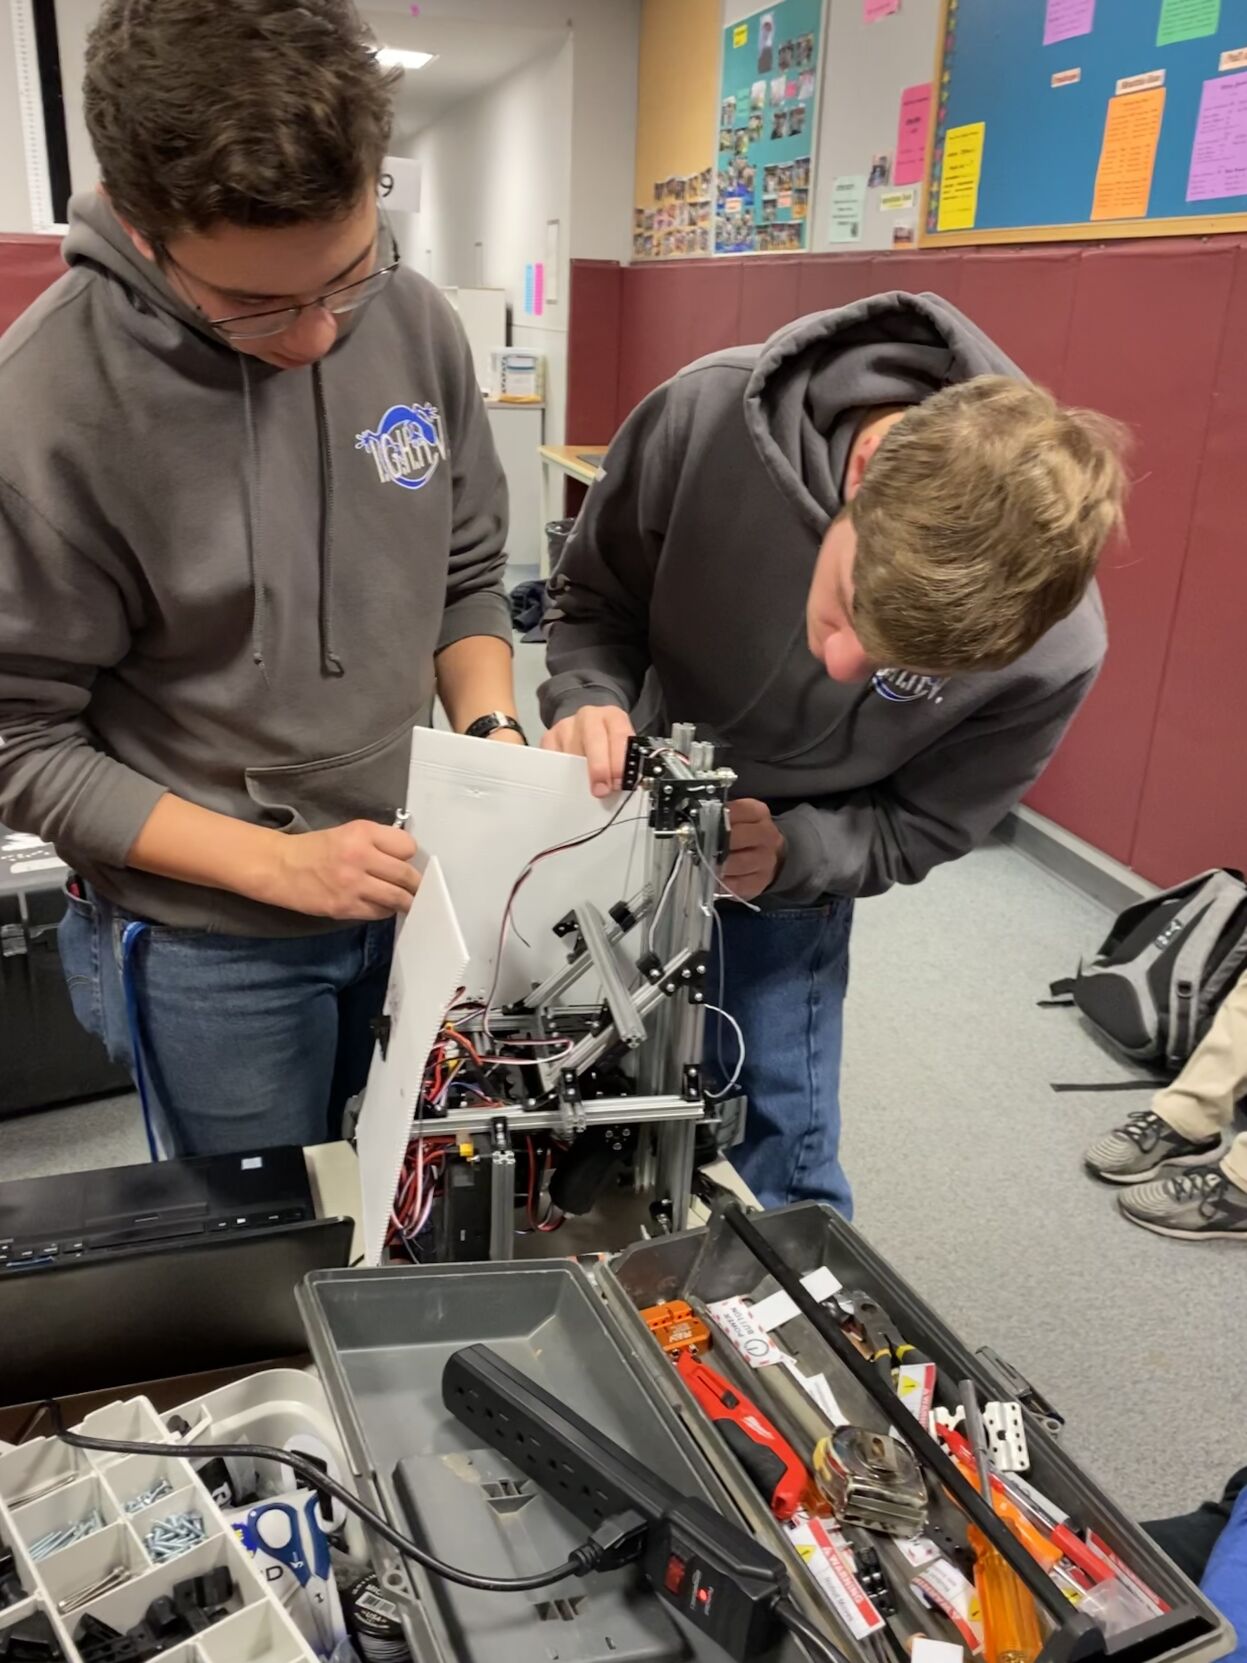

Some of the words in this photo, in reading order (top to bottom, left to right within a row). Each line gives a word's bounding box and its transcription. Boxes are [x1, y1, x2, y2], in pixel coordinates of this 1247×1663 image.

[723, 1312, 744, 1339] POWER
[731, 1306, 754, 1336] BUTTON
[828, 1553, 865, 1605] WARNING
